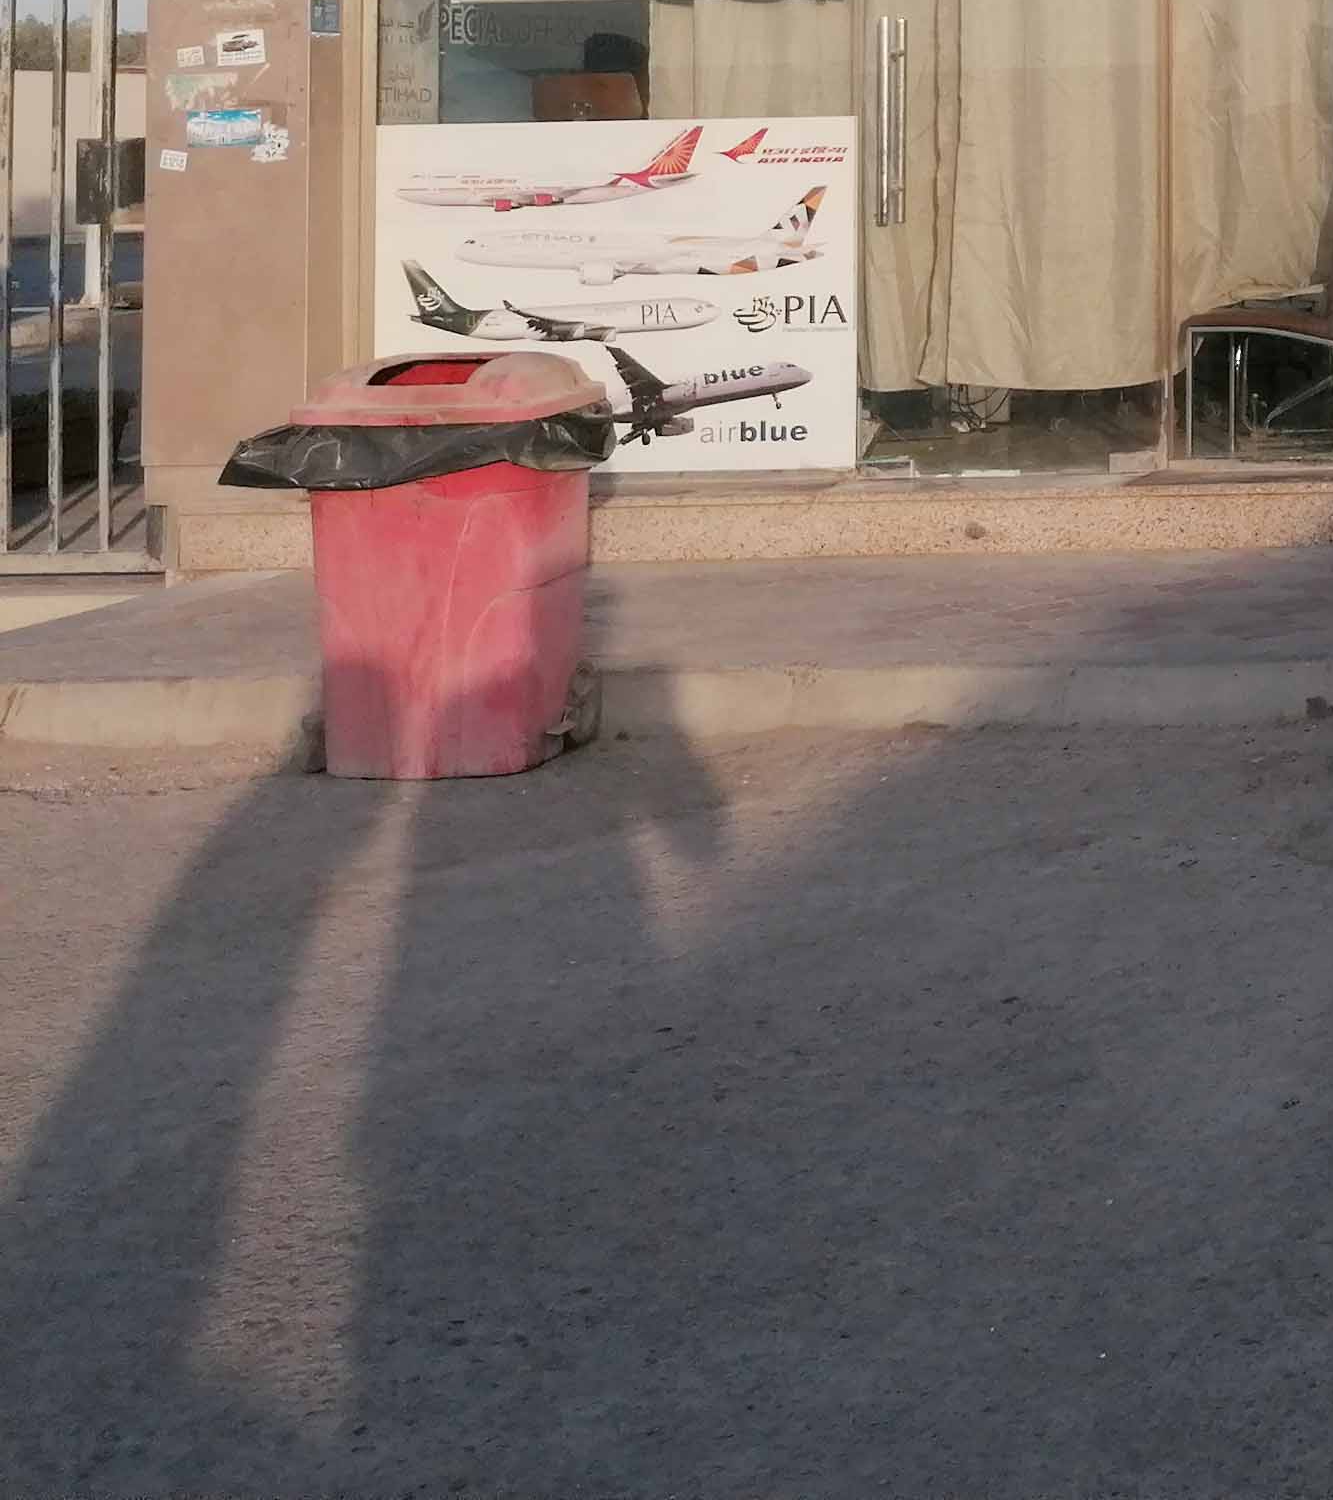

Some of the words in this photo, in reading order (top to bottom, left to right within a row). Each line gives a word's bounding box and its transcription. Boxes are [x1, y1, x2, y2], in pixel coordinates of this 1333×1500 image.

[382, 86, 432, 103] TIHAD
[640, 302, 679, 325] PIA
[783, 294, 848, 325] PIA
[703, 363, 765, 386] blue
[699, 419, 809, 444] airblue
